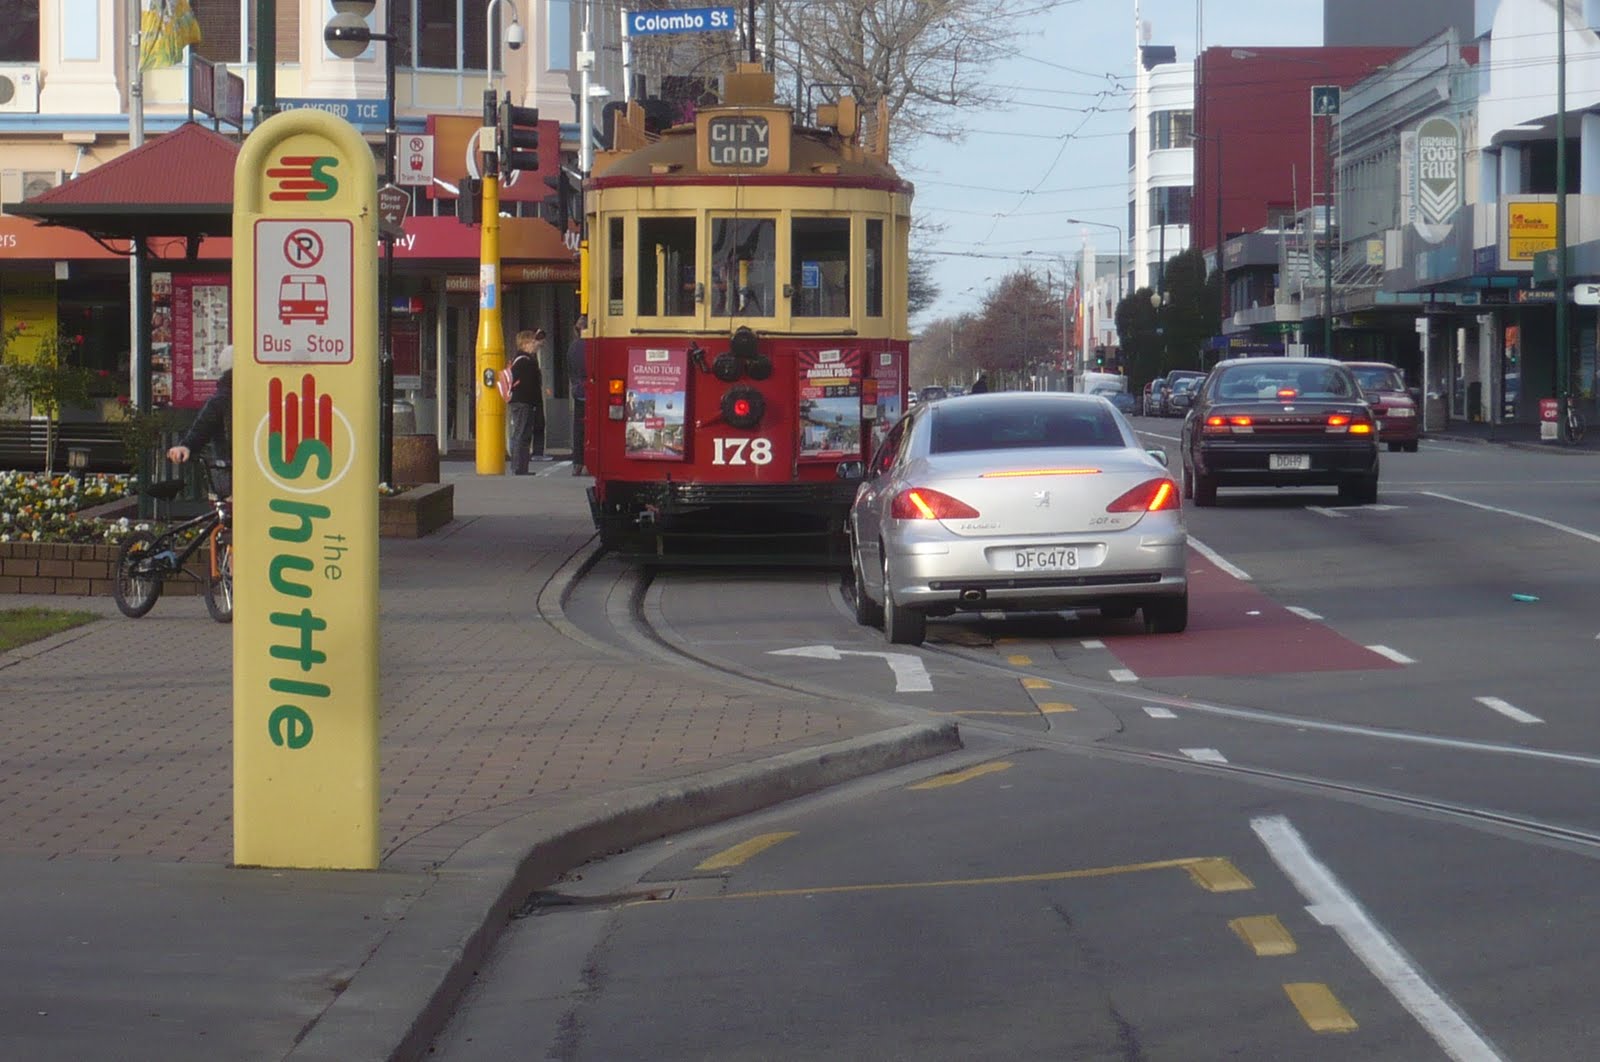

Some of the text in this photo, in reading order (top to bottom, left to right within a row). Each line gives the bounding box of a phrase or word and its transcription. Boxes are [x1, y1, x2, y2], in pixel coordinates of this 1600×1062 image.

[634, 11, 729, 31] Colombo St
[356, 104, 379, 118] TCE
[712, 124, 768, 142] CITY
[711, 146, 768, 163] LOOP
[1420, 146, 1457, 161] FOOD
[1420, 162, 1457, 179] FAIR
[263, 334, 344, 356] Bus Stop
[633, 364, 681, 375] GRAND TOUR
[712, 438, 773, 465] 178
[323, 533, 349, 581] the
[1015, 551, 1077, 568] DFG478
